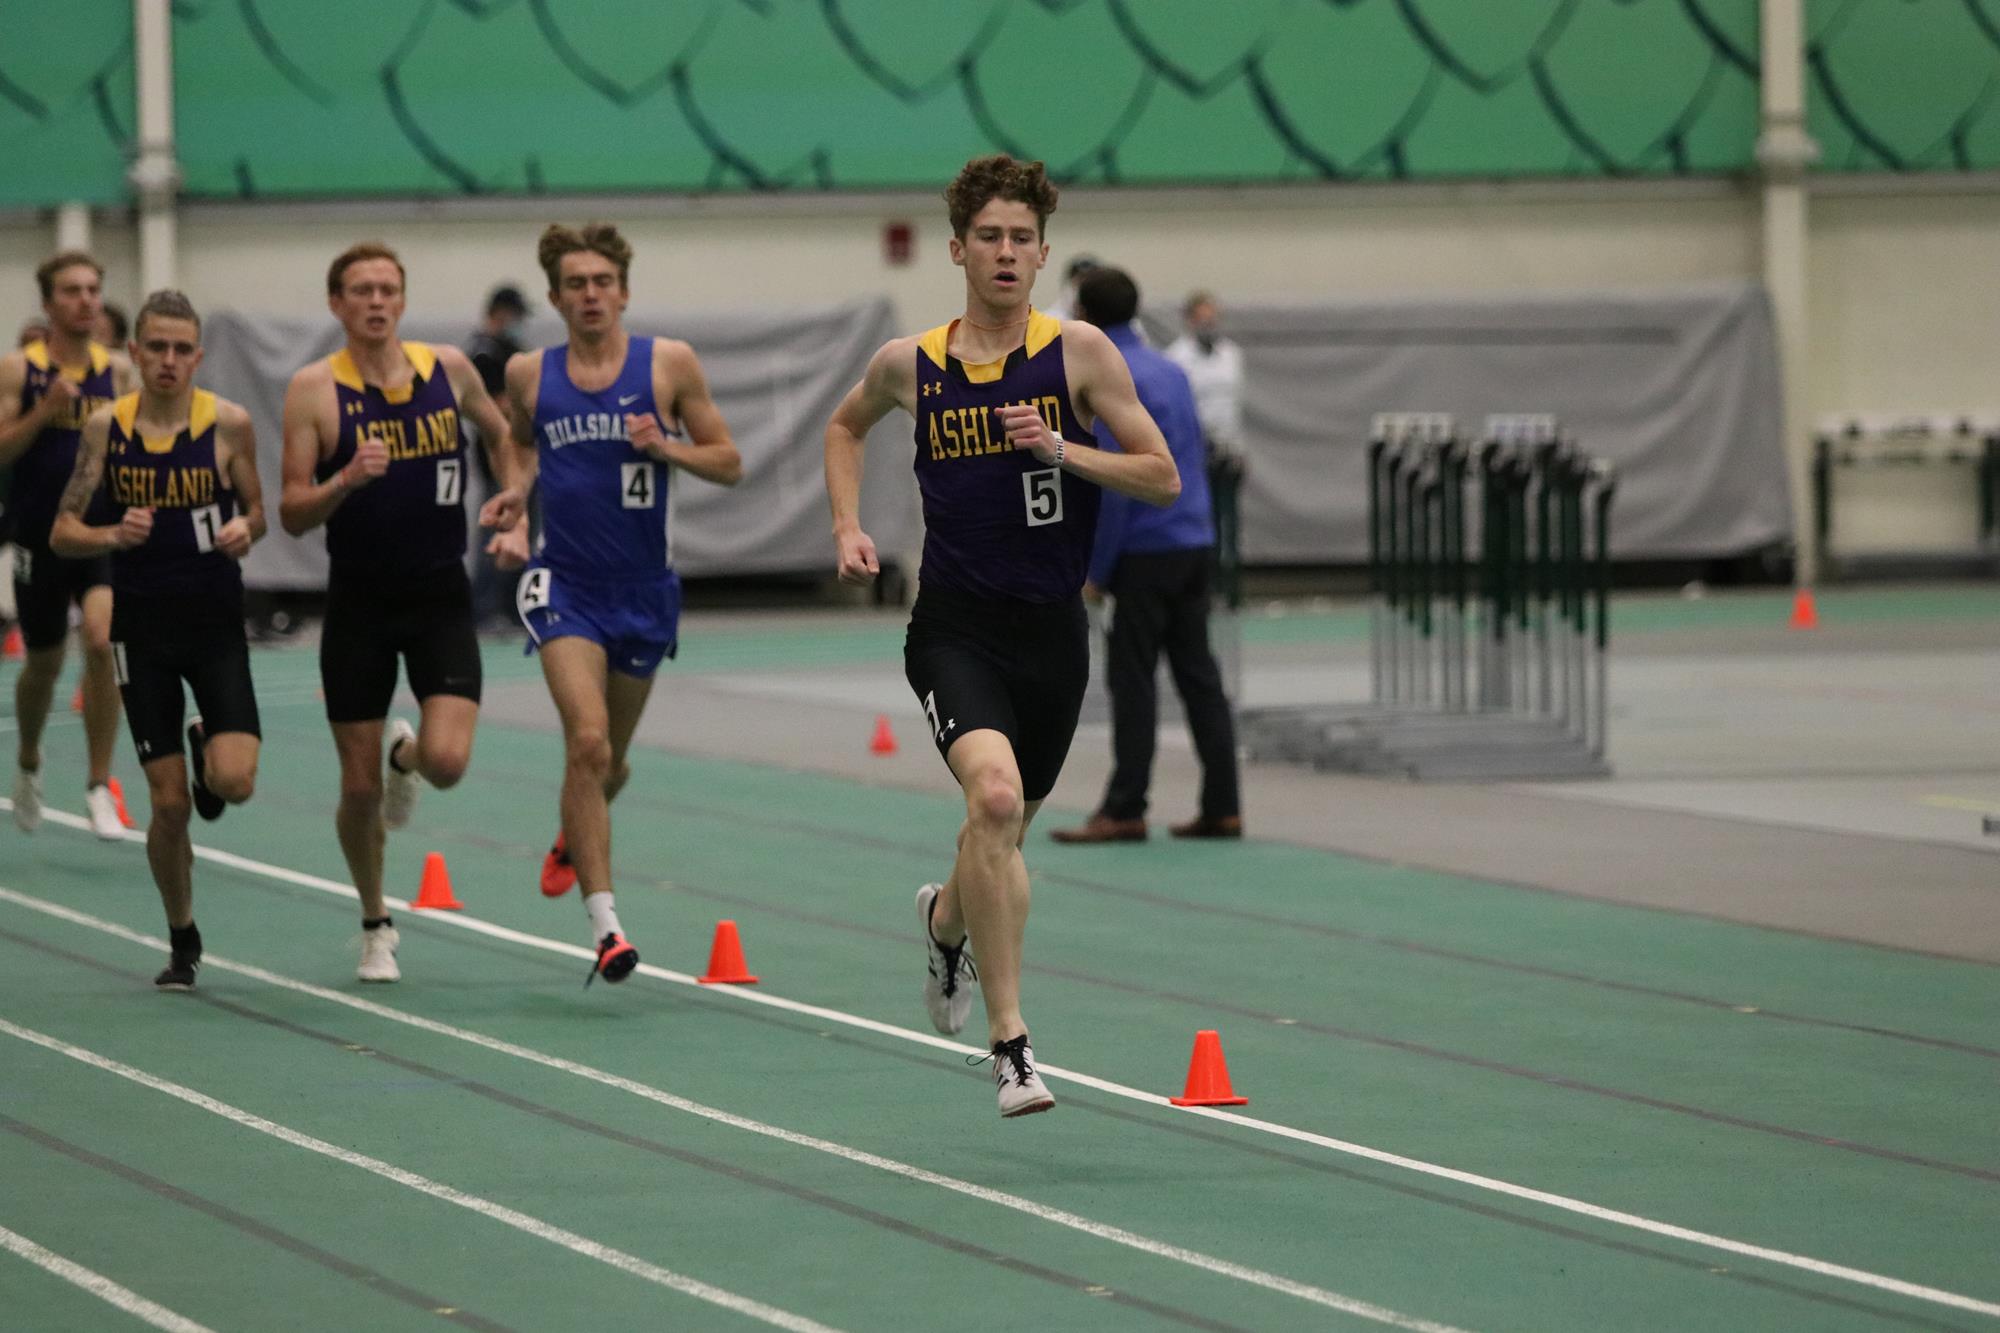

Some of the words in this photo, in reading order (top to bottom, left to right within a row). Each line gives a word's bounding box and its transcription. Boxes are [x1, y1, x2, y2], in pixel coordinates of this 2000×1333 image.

[544, 412, 633, 450] HILLSDA
[929, 395, 1063, 461] ASHLD
[442, 465, 456, 500] 7
[627, 467, 649, 504] 4
[1030, 471, 1058, 521] 5
[199, 511, 214, 546] 1
